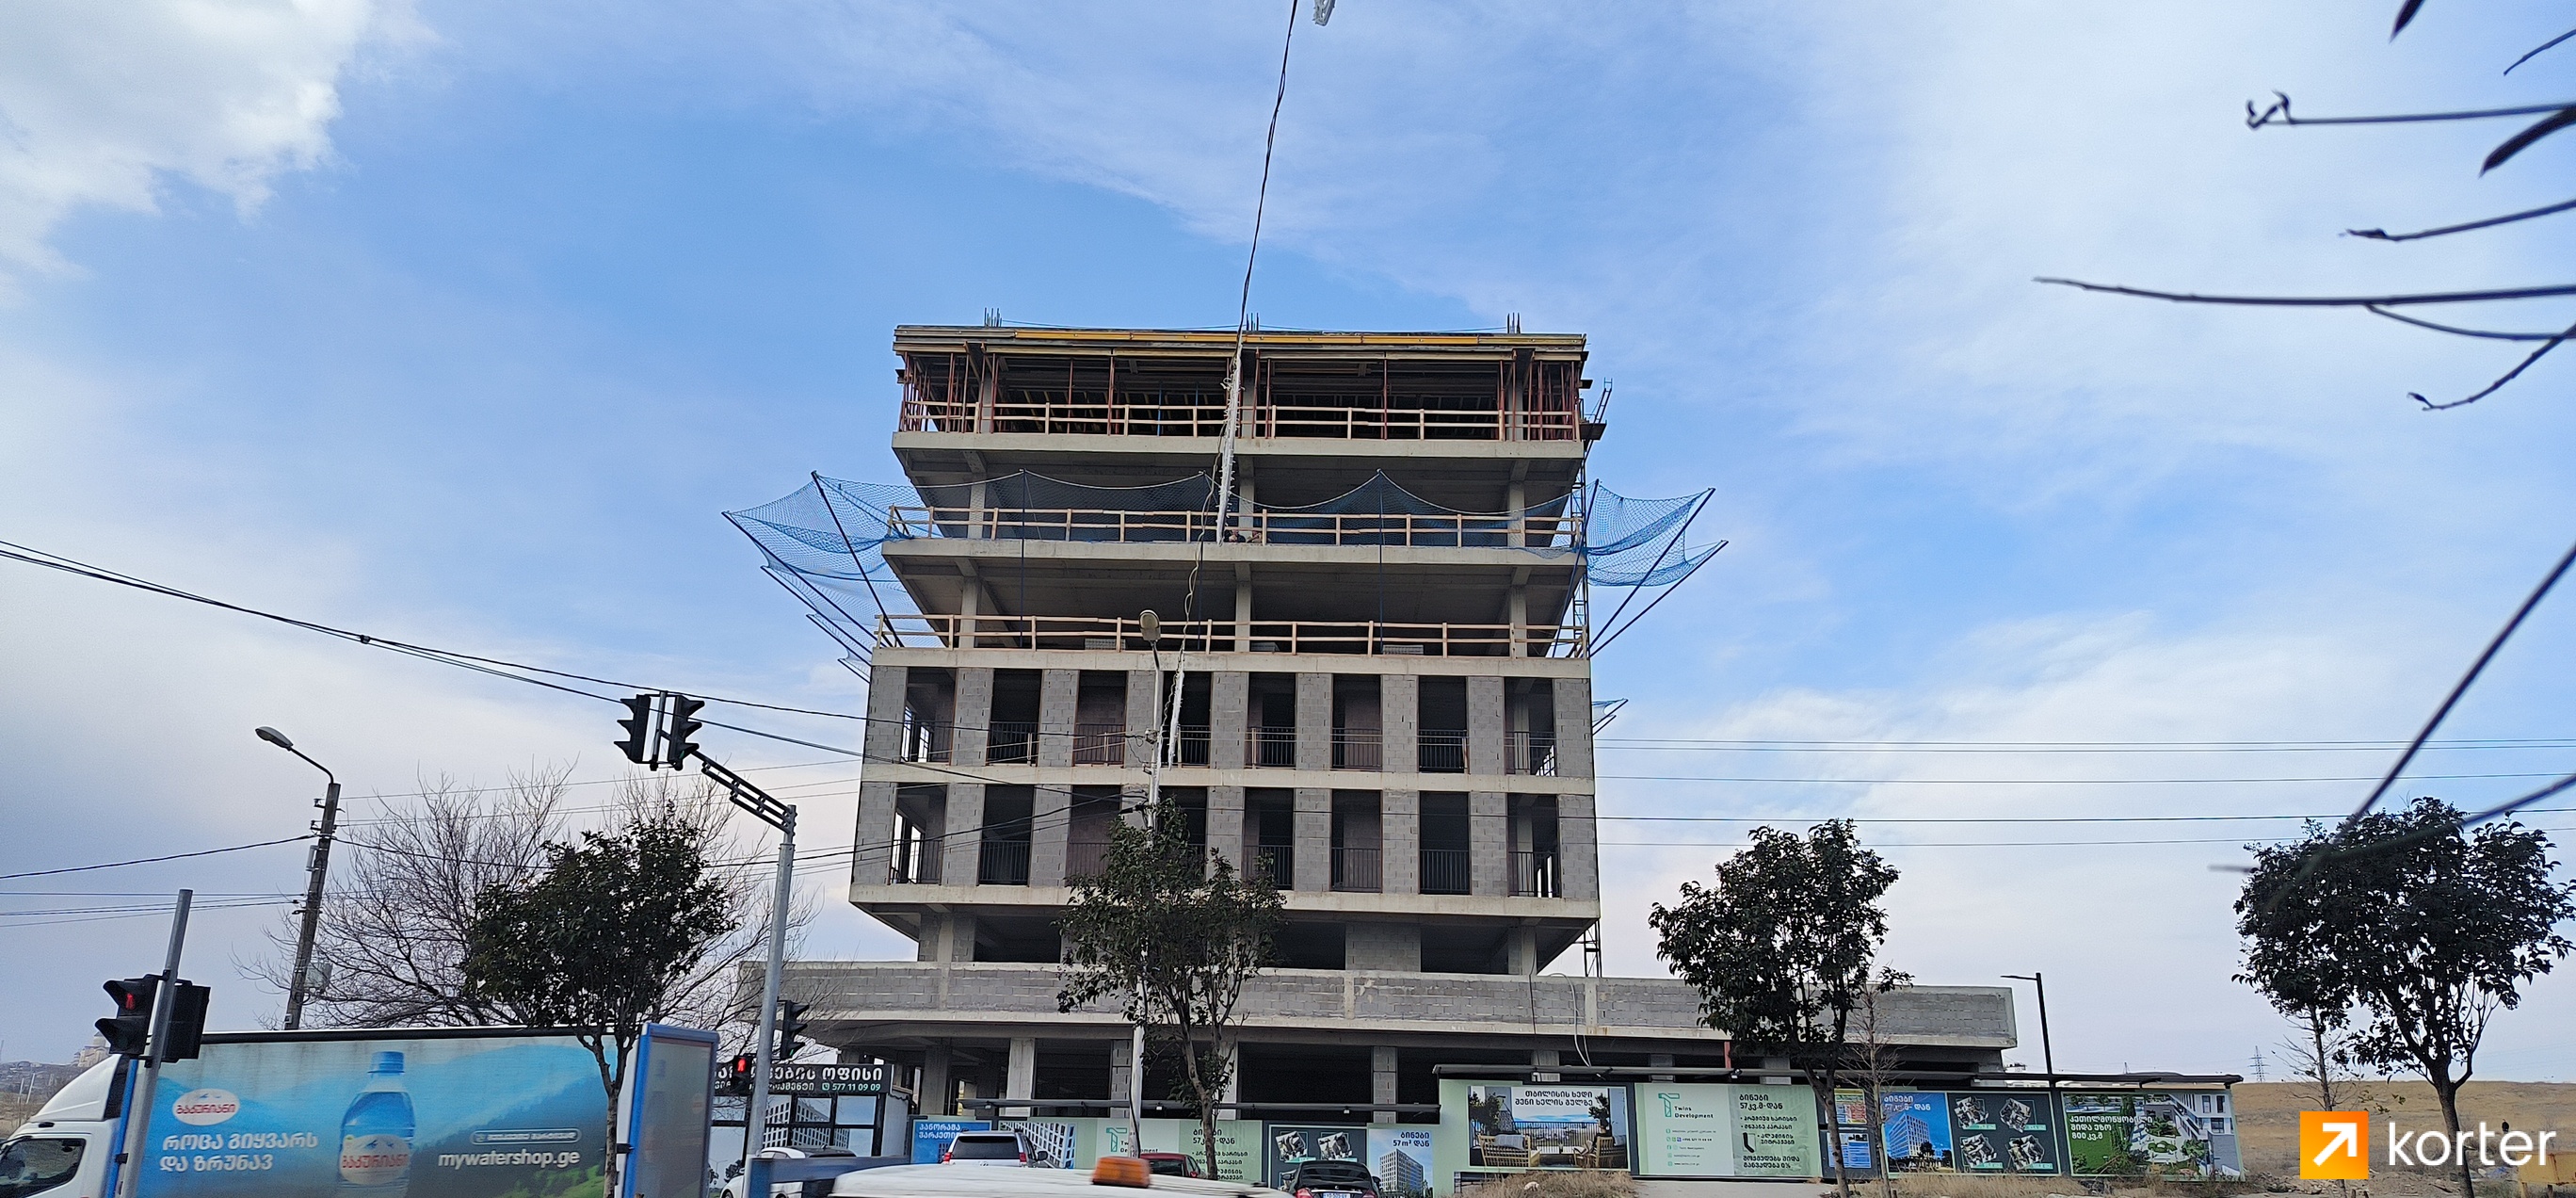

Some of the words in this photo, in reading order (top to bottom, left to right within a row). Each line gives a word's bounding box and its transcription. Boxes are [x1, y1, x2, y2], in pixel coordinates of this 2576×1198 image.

[822, 1066, 883, 1081] ოფისი
[919, 1123, 960, 1131] პანორამა
[162, 1133, 224, 1151] როცა
[228, 1132, 319, 1150] გიყვარს
[159, 1155, 189, 1173] და
[193, 1154, 274, 1172] ზრუნავ
[438, 1148, 581, 1170] mywatershop.ge
